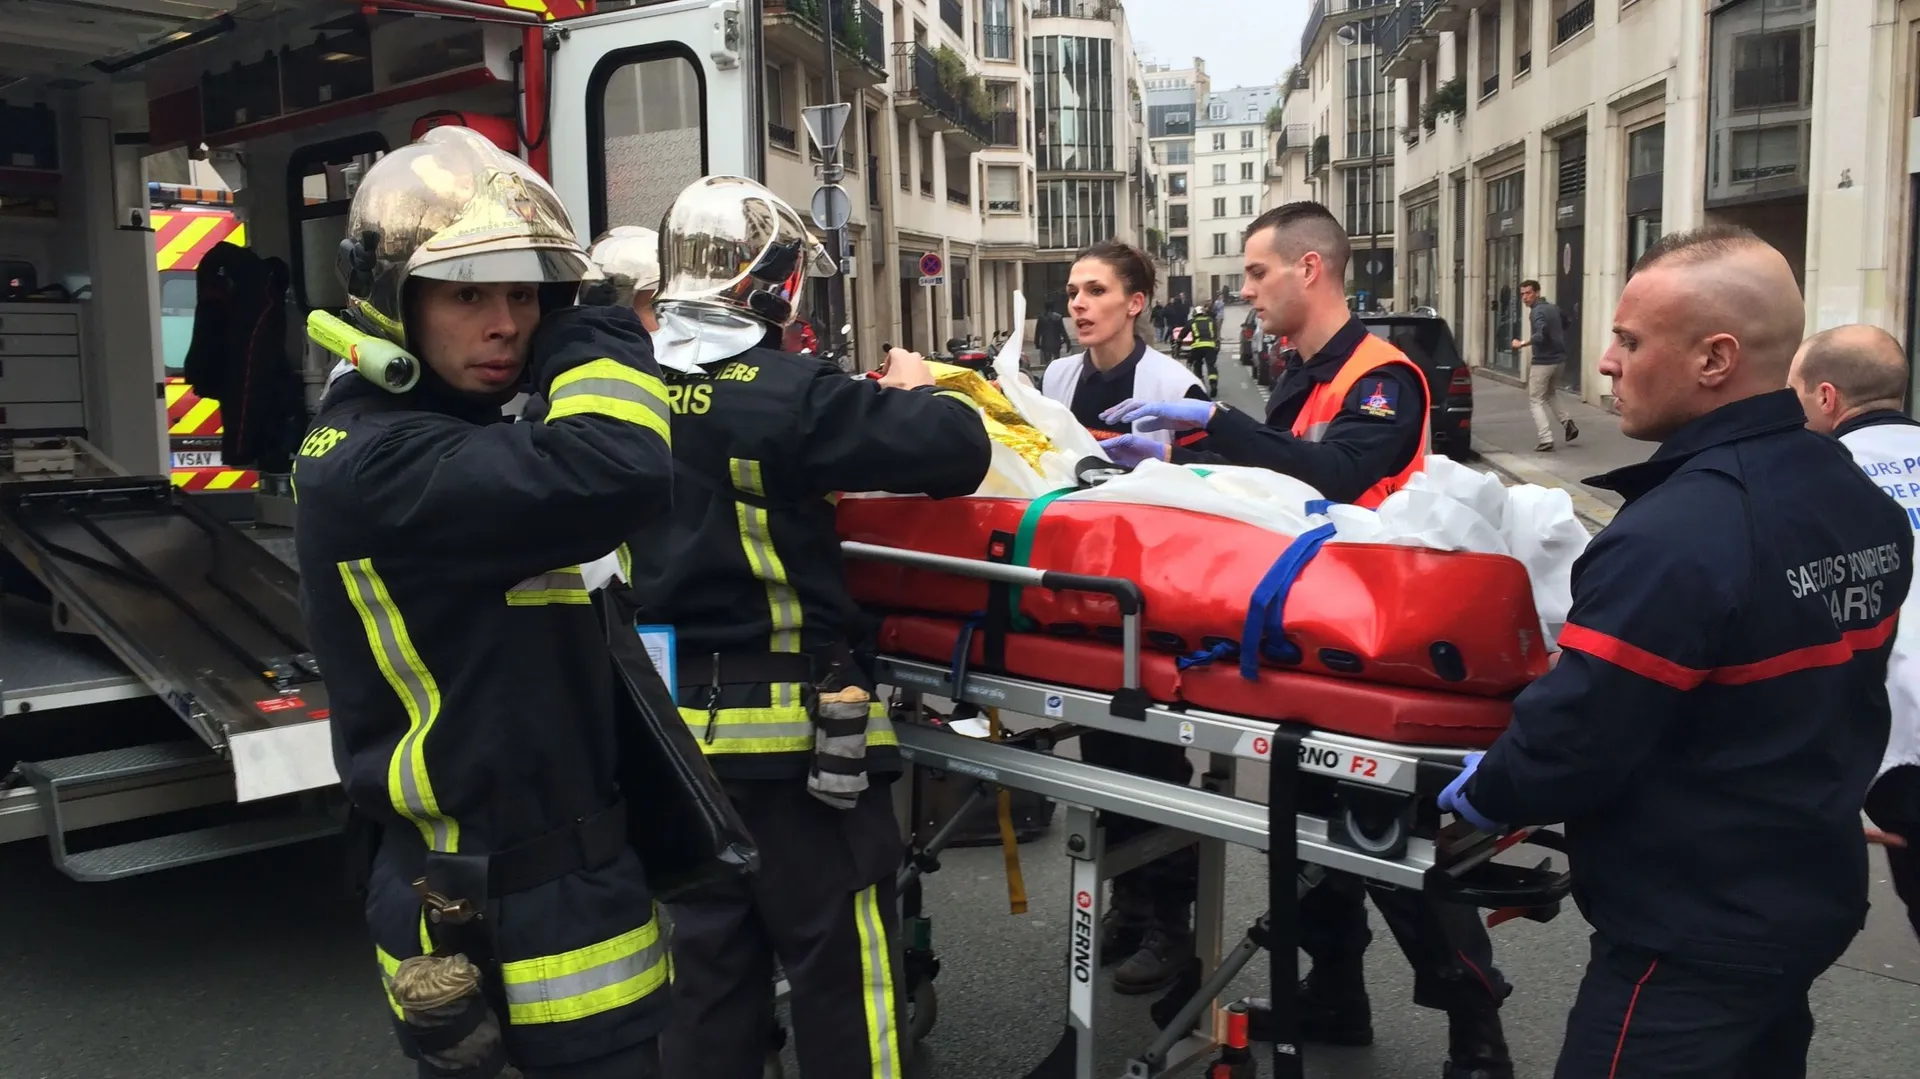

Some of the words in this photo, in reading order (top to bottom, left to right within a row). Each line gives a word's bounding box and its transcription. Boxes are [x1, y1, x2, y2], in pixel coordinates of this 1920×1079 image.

[668, 384, 713, 414] RIS
[177, 453, 212, 466] VSAV
[1862, 461, 1902, 477] URS
[1823, 580, 1884, 625] ARIS
[1349, 755, 1378, 777] F2
[1075, 908, 1091, 983] FERNO
